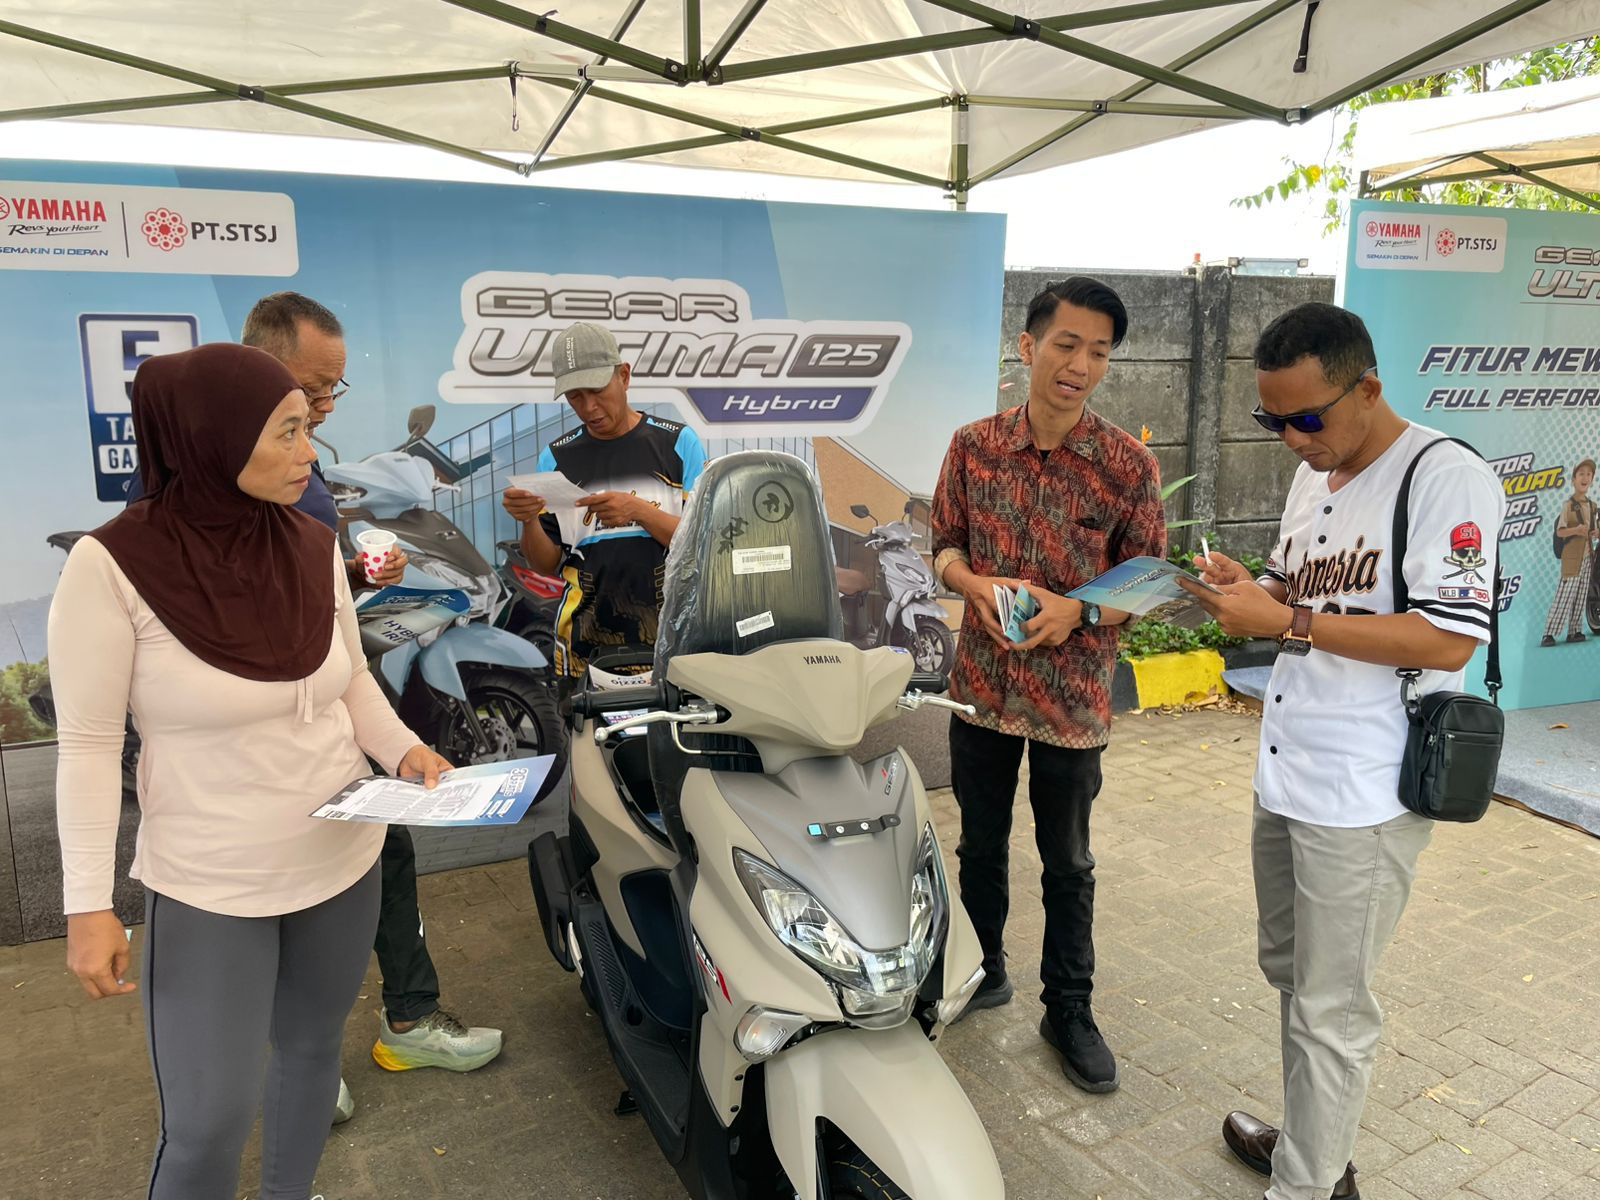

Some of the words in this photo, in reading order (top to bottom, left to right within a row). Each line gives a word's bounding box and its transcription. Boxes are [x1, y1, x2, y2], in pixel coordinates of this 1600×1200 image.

[11, 197, 107, 222] YAMAHA
[8, 224, 46, 236] Revs
[46, 225, 70, 236] your
[71, 224, 100, 232] Heart
[191, 221, 277, 243] PT.STSJ
[1379, 223, 1421, 239] YAMAHA
[67, 248, 108, 256] DEPAN
[1457, 237, 1497, 251] PT.STSJ
[1535, 245, 1600, 266] GE
[1528, 268, 1600, 299] ULT
[476, 286, 739, 322] GEAR
[807, 342, 883, 367] 125
[1419, 346, 1531, 373] FITUR
[723, 393, 841, 416] Hybrid
[1425, 388, 1491, 409] FULL
[1497, 387, 1600, 409] PERFOR
[1488, 452, 1535, 476] TOR
[1506, 495, 1538, 519] AT,
[1498, 516, 1542, 542] IRIT
[803, 655, 842, 665] YAMAHA
